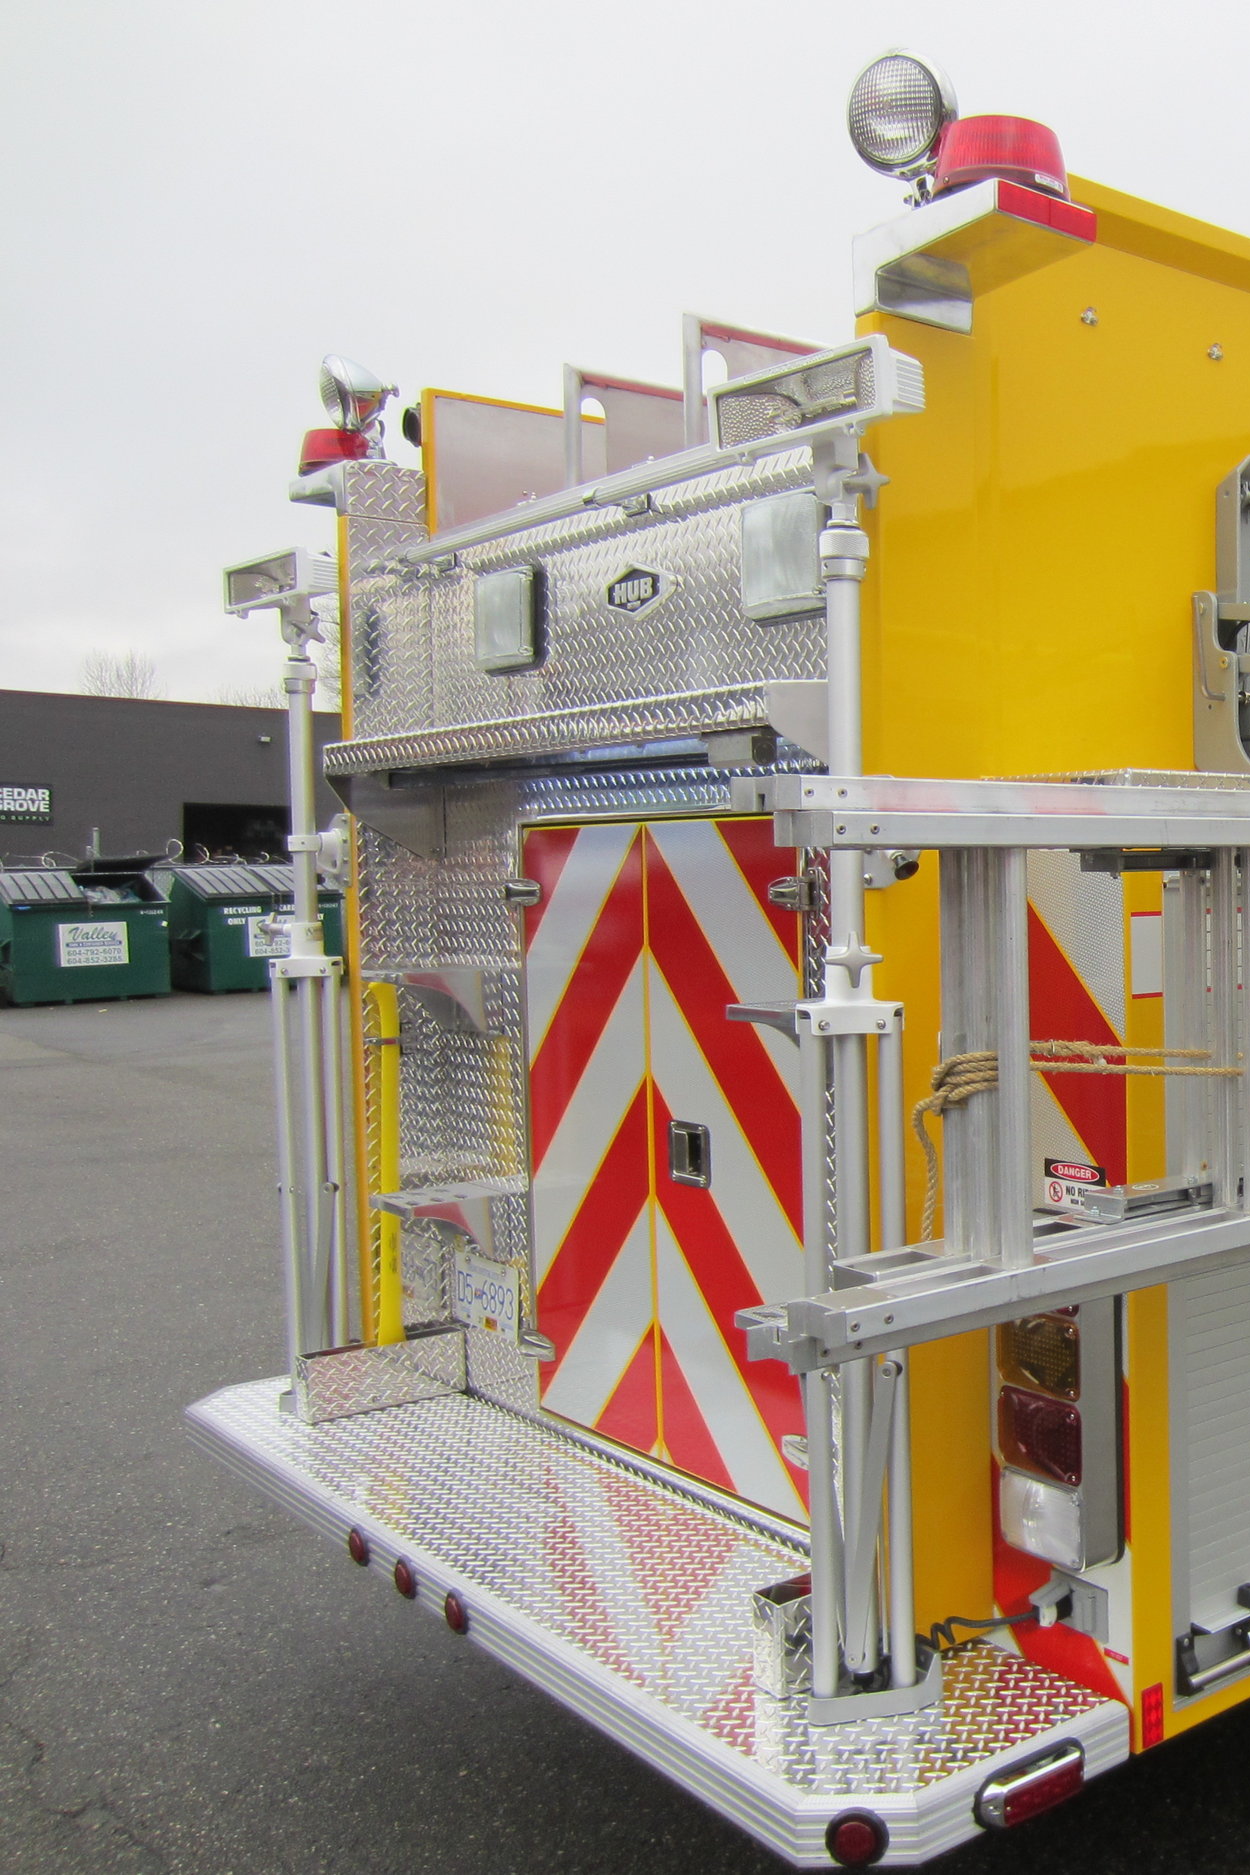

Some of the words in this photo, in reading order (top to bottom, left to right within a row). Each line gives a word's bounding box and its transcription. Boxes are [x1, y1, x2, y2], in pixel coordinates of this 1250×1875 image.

[614, 577, 653, 605] HUB
[0, 787, 50, 801] EDAR
[223, 906, 262, 915] RECYCLING
[227, 917, 246, 925] ONLY
[68, 926, 118, 942] Valley
[1057, 1165, 1092, 1180] DANGER
[1065, 1185, 1076, 1197] NO
[481, 1279, 514, 1321] 6893
